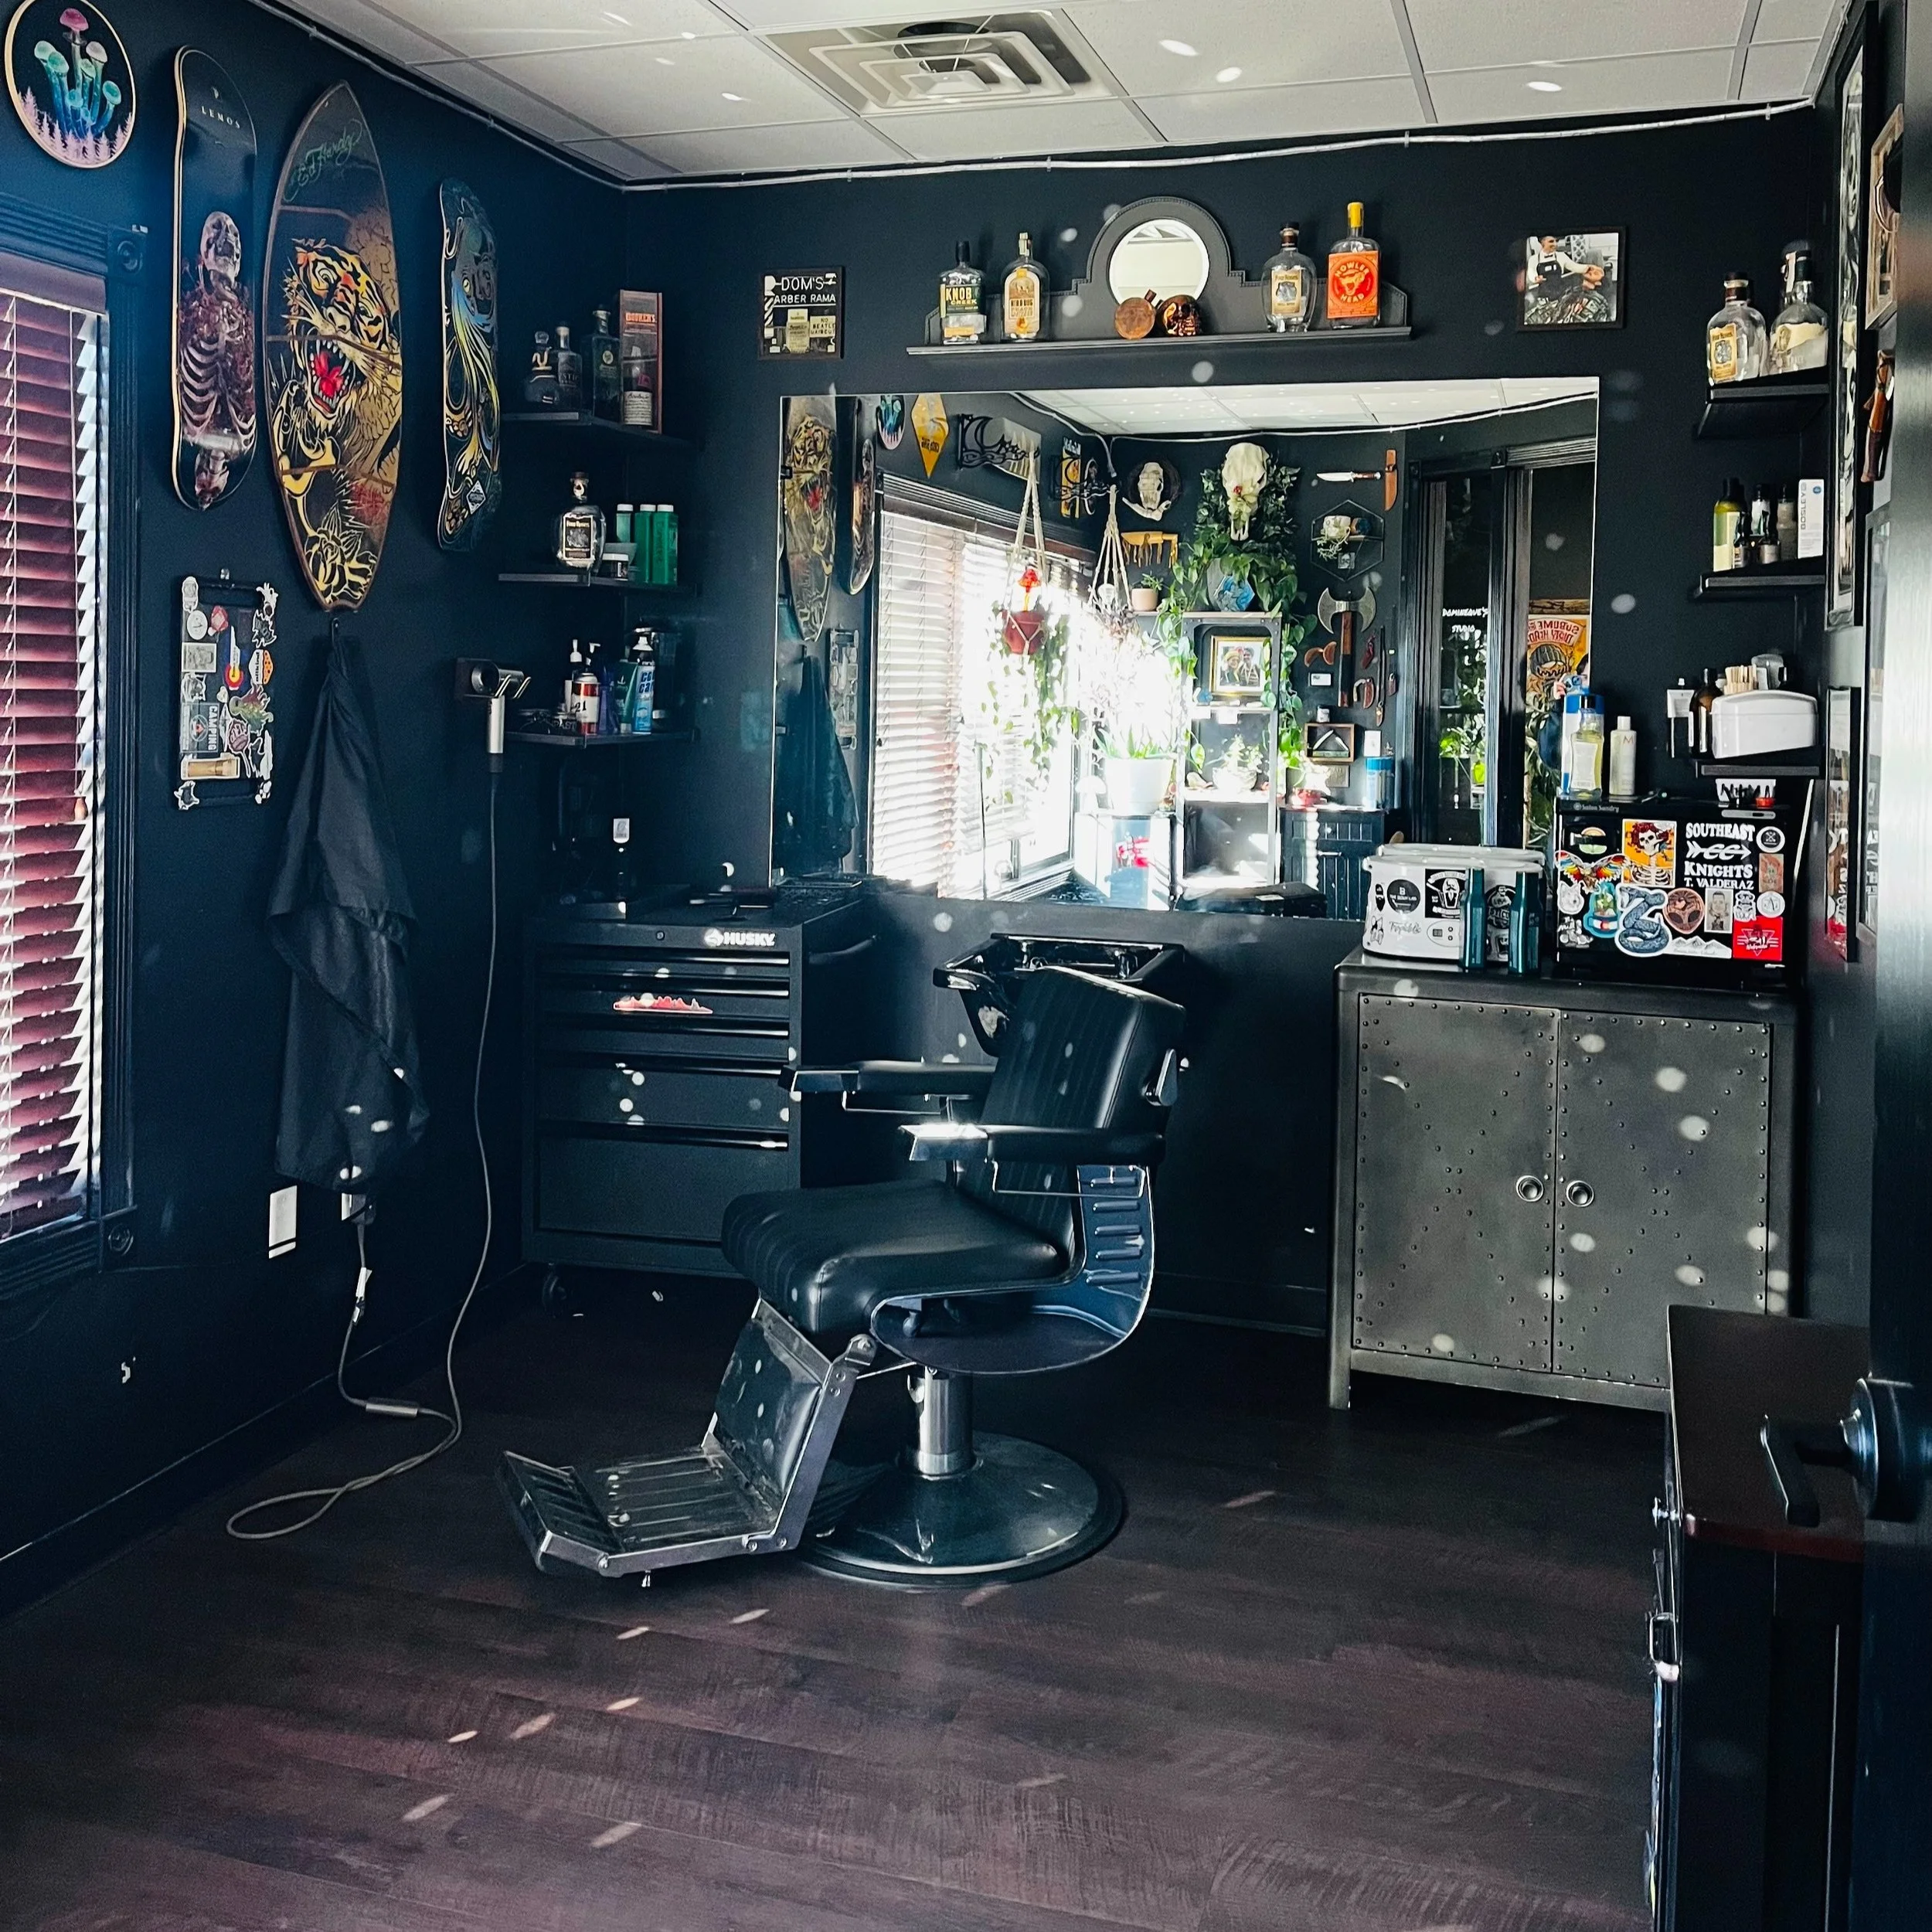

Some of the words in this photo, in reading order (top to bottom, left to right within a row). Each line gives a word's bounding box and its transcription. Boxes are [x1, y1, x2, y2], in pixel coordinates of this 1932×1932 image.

[1335, 261, 1369, 277] HOWLER
[781, 277, 824, 291] DOM'S
[774, 294, 806, 304] ARBER
[811, 294, 836, 302] RAMA
[945, 287, 972, 301] KNOB
[1340, 294, 1365, 303] HEAD
[1452, 624, 1475, 633] STUDIO
[207, 705, 218, 751] CAMPING
[1624, 736, 1634, 745] M
[1685, 822, 1755, 842] SOUTHEAST
[1684, 860, 1753, 879] KNIGHTS
[1684, 877, 1693, 887] T.
[1696, 878, 1754, 890] VALDERAZ
[723, 932, 775, 946] HUSKY
